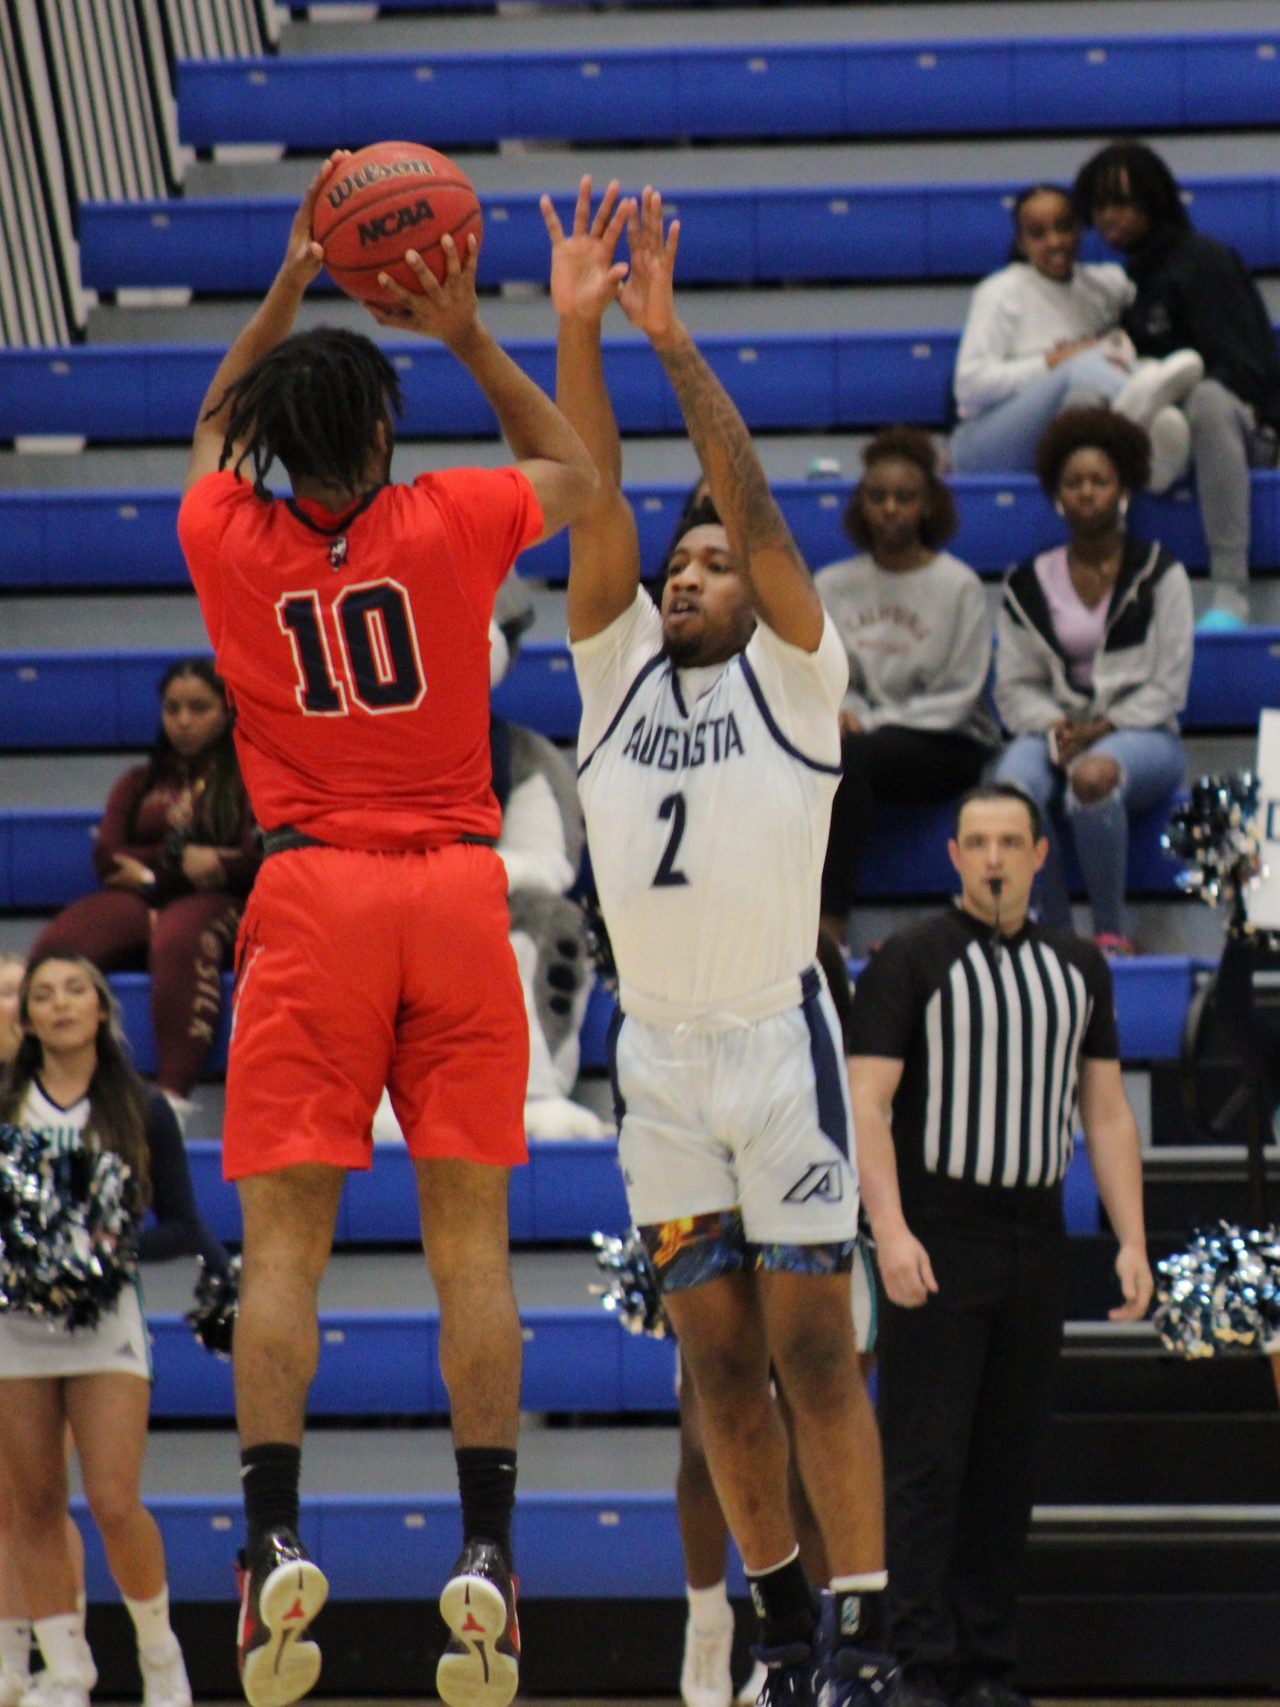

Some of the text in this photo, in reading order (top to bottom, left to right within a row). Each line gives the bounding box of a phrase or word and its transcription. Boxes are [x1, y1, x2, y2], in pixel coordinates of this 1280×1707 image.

[327, 160, 435, 209] Wilson
[357, 198, 435, 247] NCAA
[275, 577, 427, 716] 10
[622, 710, 744, 772] AUGUSTA
[652, 792, 688, 886] 2
